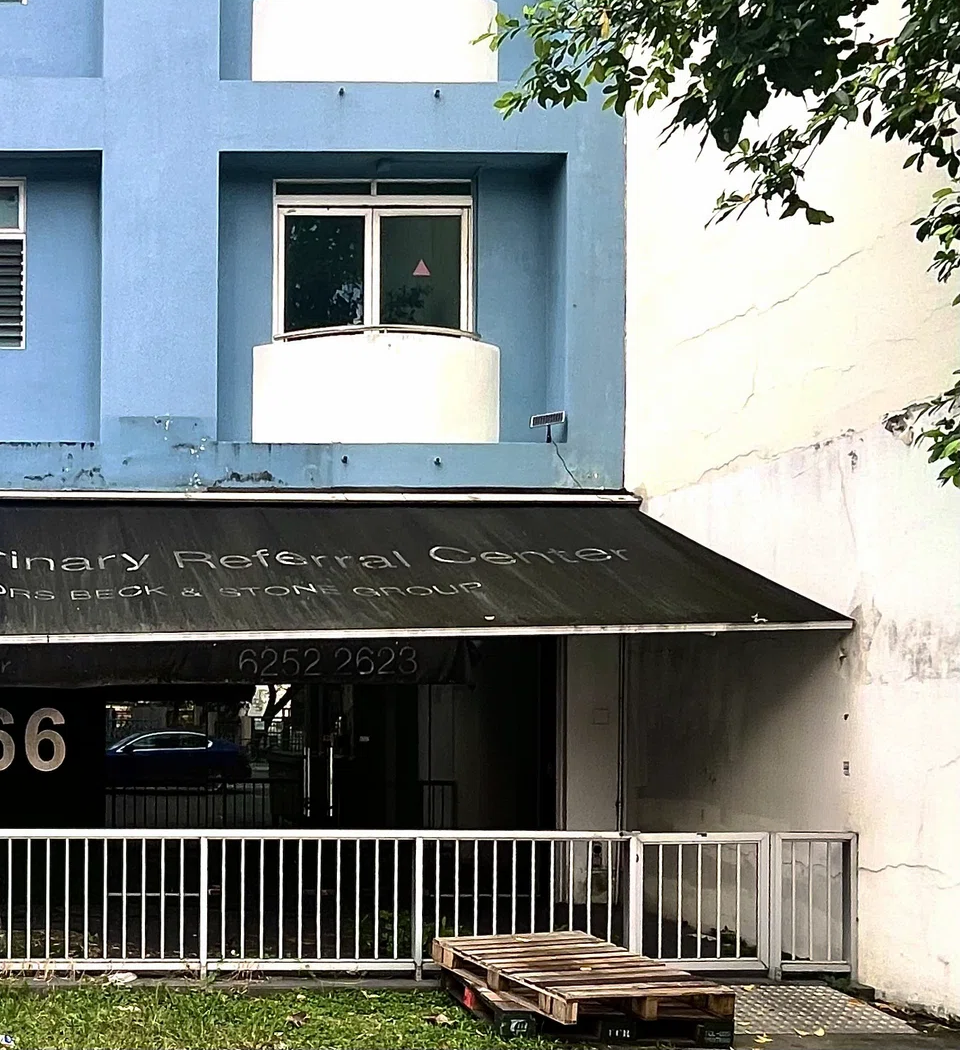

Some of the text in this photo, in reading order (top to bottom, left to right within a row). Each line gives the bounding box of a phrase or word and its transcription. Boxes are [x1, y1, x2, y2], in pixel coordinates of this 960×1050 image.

[172, 548, 411, 570] Referral
[428, 545, 630, 565] Center
[70, 584, 168, 601] BECK
[181, 586, 203, 598] &
[218, 583, 341, 598] STONE
[351, 581, 482, 597] GROUP
[239, 647, 323, 677] 6252
[334, 646, 418, 676] 2623
